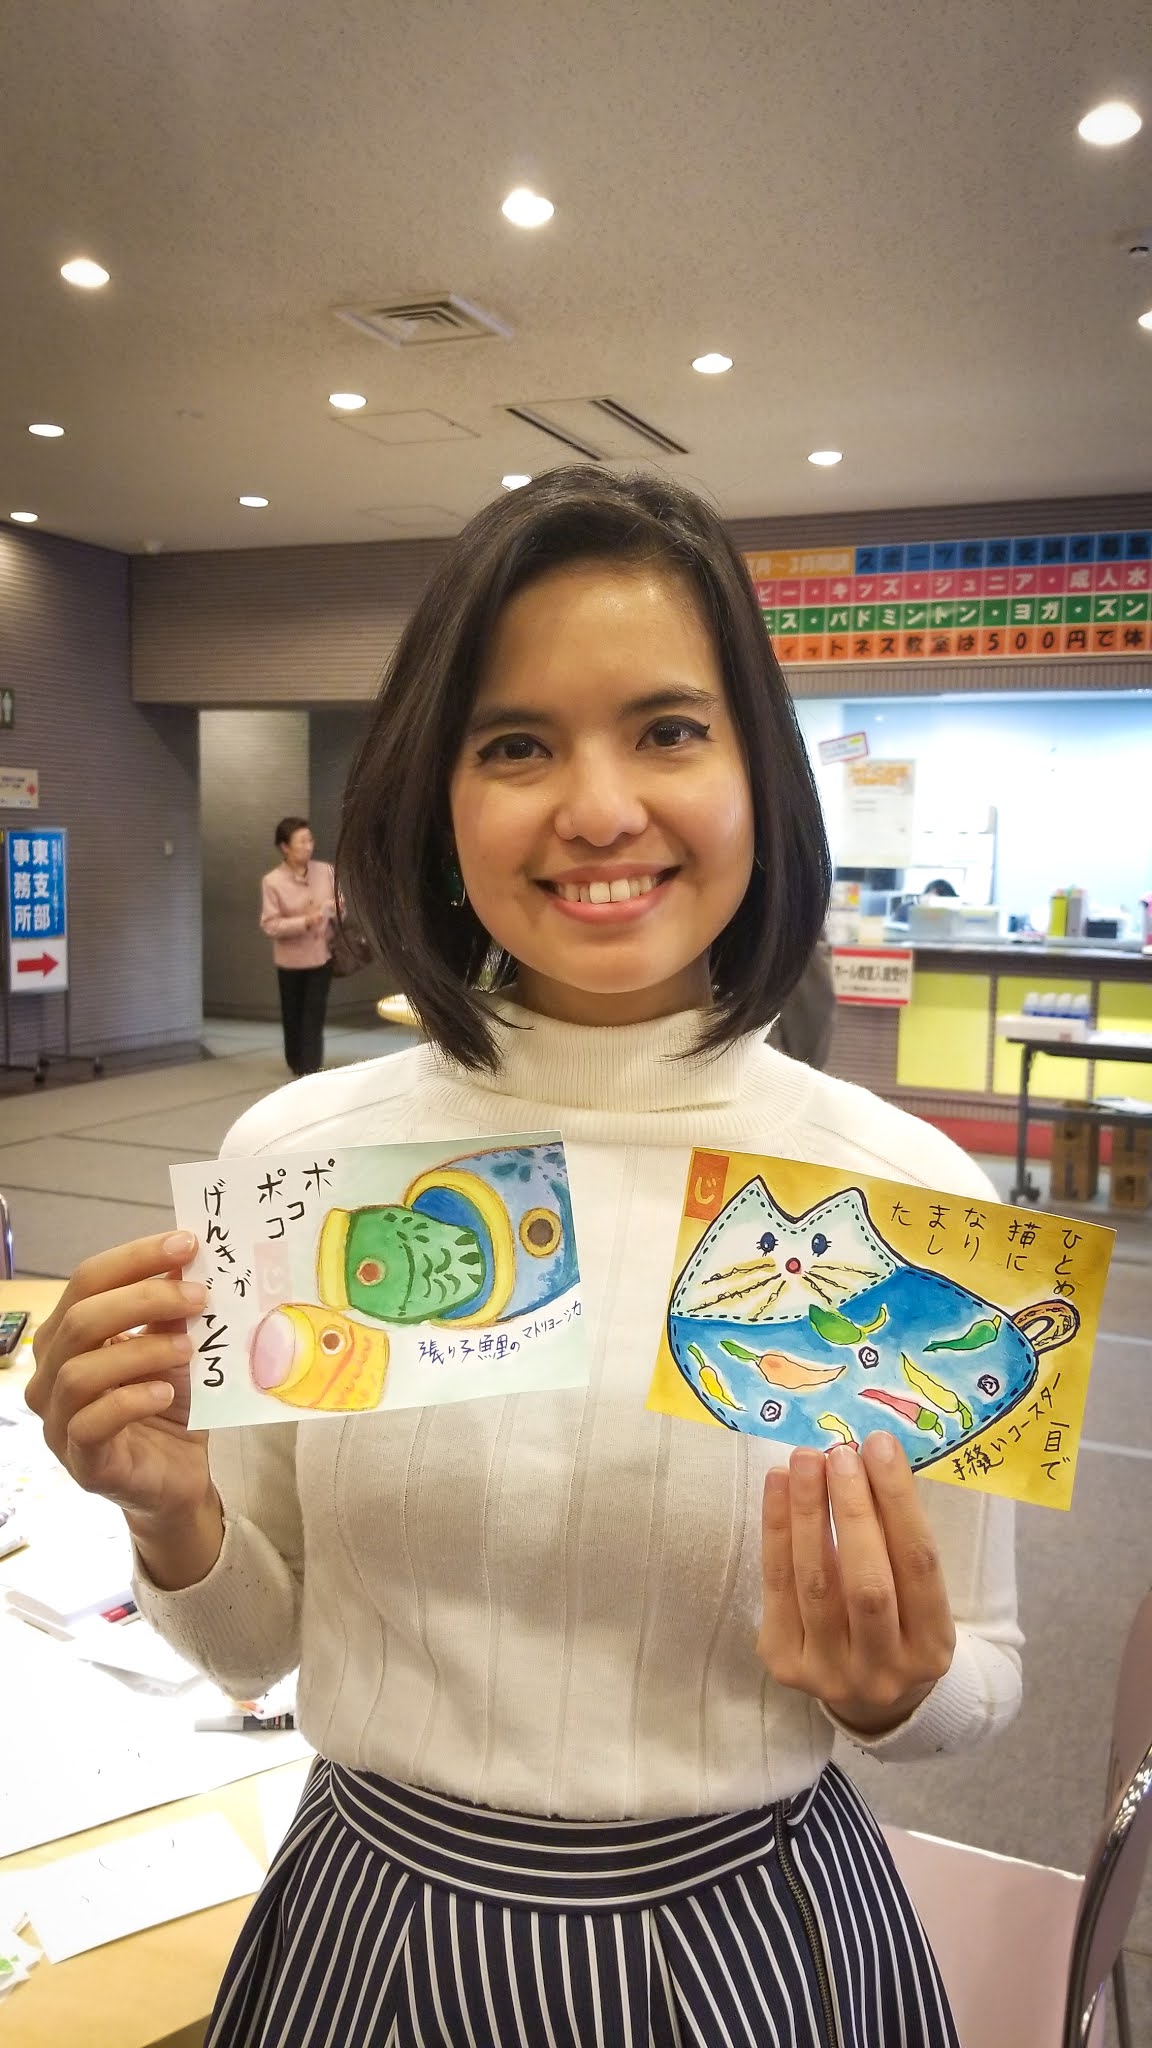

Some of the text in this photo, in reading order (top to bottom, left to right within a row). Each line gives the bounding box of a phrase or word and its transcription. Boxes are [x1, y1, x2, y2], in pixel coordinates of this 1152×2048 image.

[13, 838, 31, 932] 事務所
[32, 838, 50, 931] 東支部
